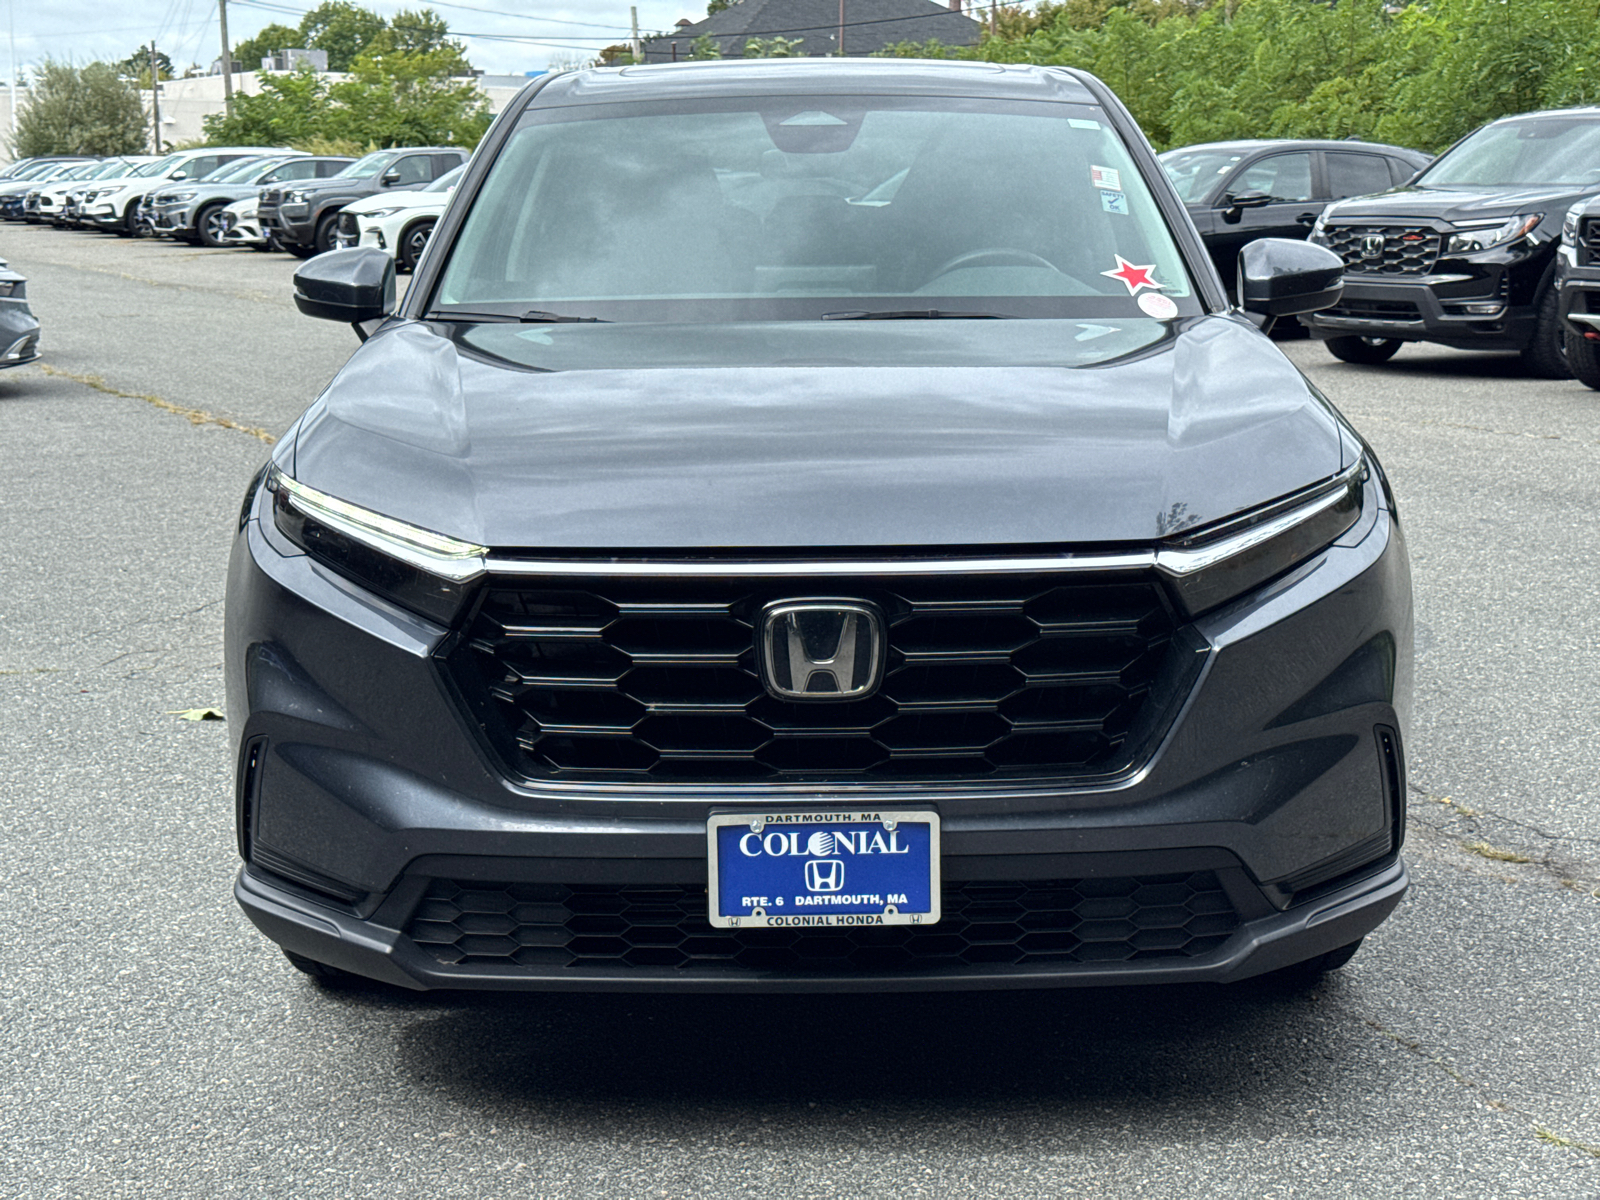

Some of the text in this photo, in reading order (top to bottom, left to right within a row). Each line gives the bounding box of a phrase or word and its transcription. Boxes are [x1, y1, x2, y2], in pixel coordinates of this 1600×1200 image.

[1101, 191, 1124, 199] SAFETY
[765, 813, 882, 823] DARTMOUTH, MA
[739, 830, 909, 857] COLONIAL
[741, 893, 908, 907] RTE. 6 DARTMOUTH, MA
[766, 915, 884, 926] COLONIAL HONDA
